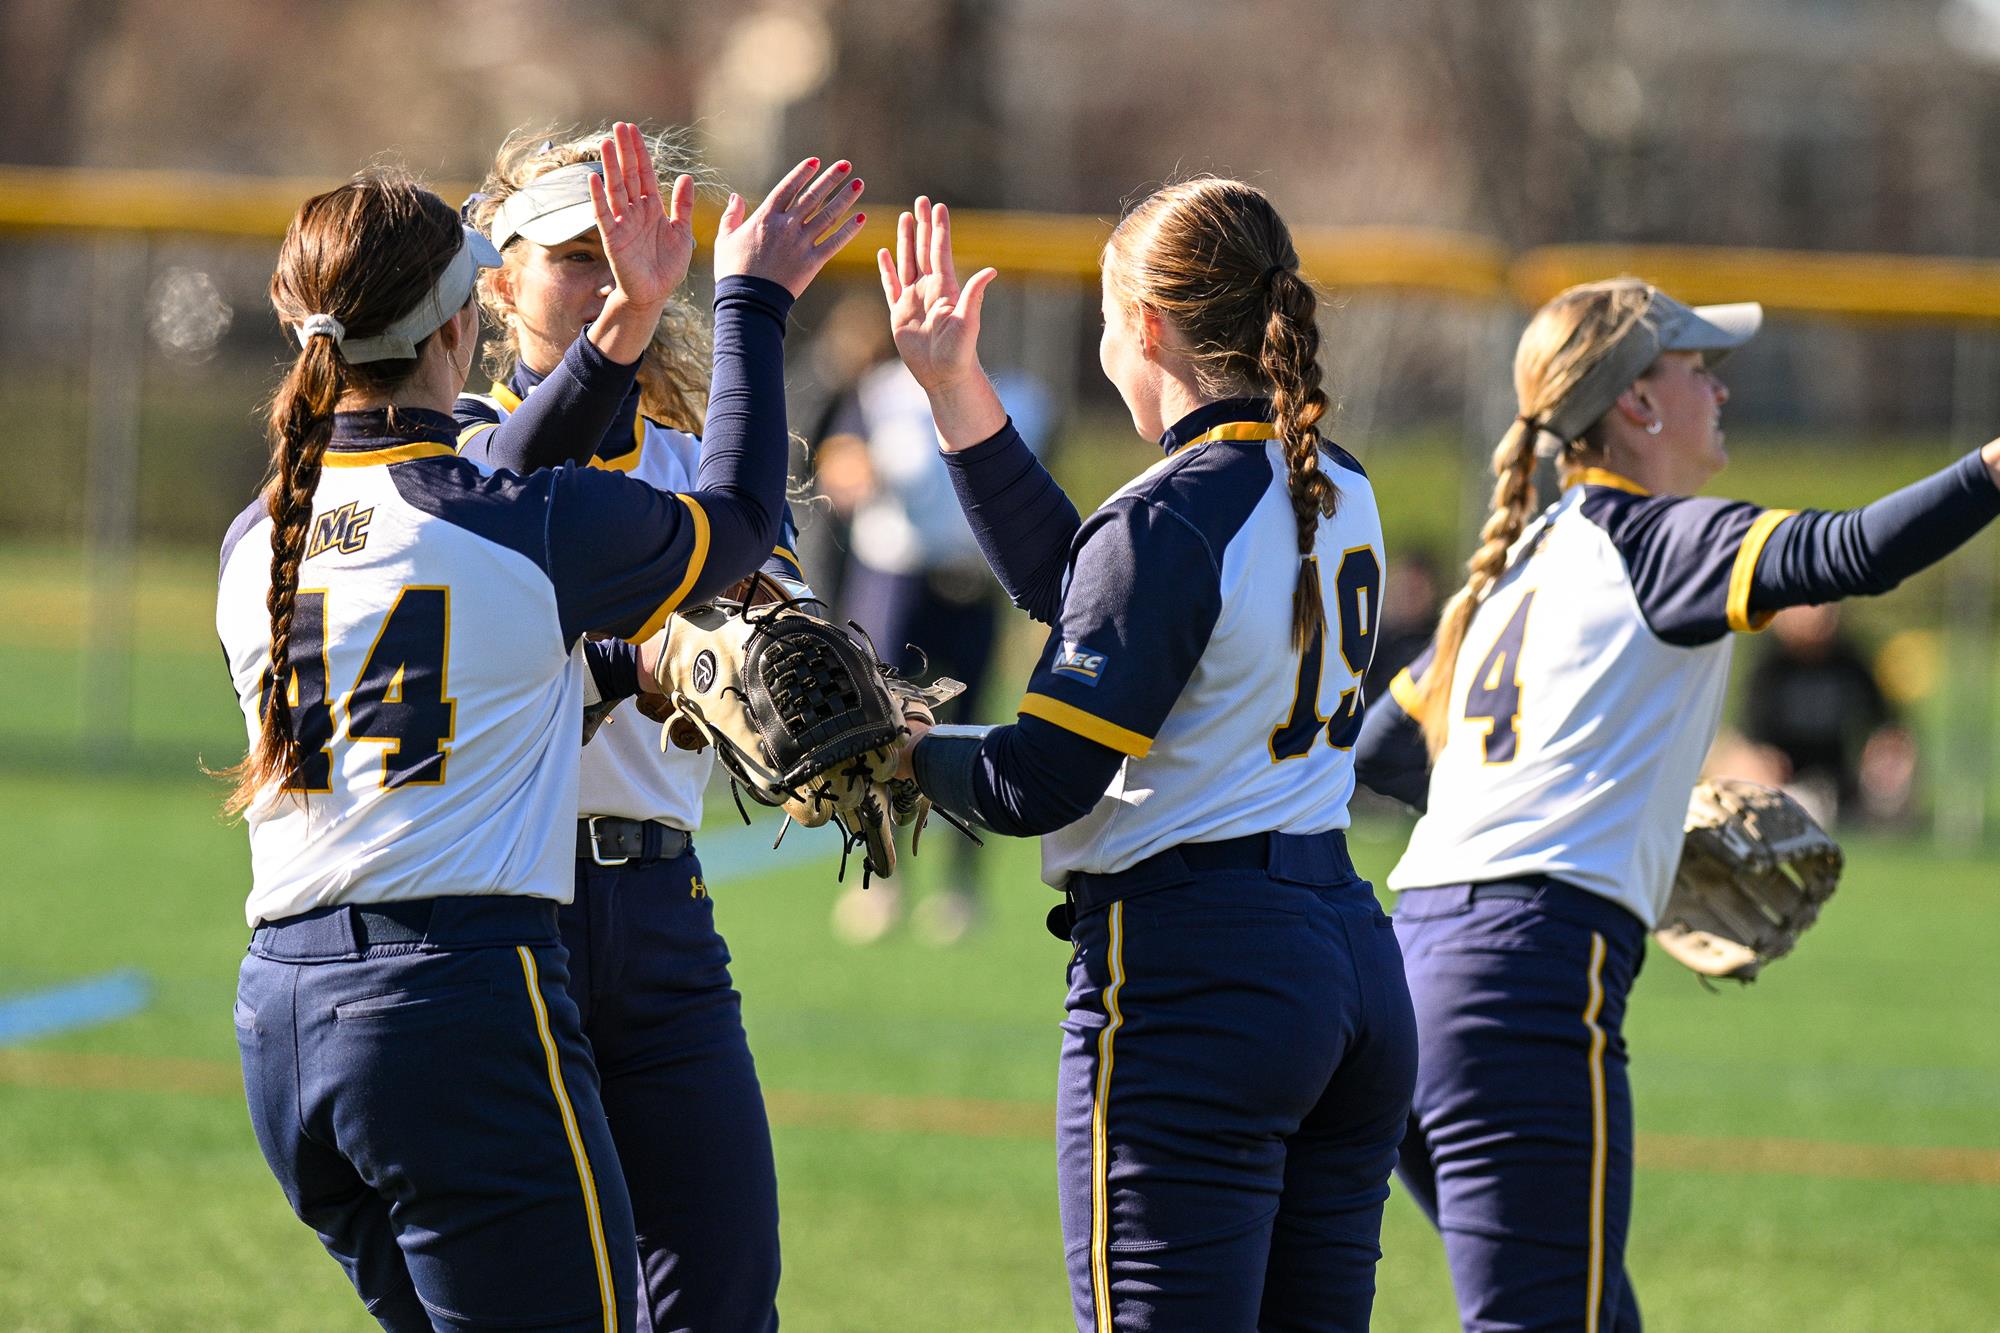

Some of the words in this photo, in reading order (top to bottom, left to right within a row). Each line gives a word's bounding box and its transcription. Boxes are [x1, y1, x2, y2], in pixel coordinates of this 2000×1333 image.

[305, 500, 375, 561] MC
[257, 585, 457, 794] 44
[1268, 544, 1381, 764] 19
[1464, 586, 1538, 767] 4
